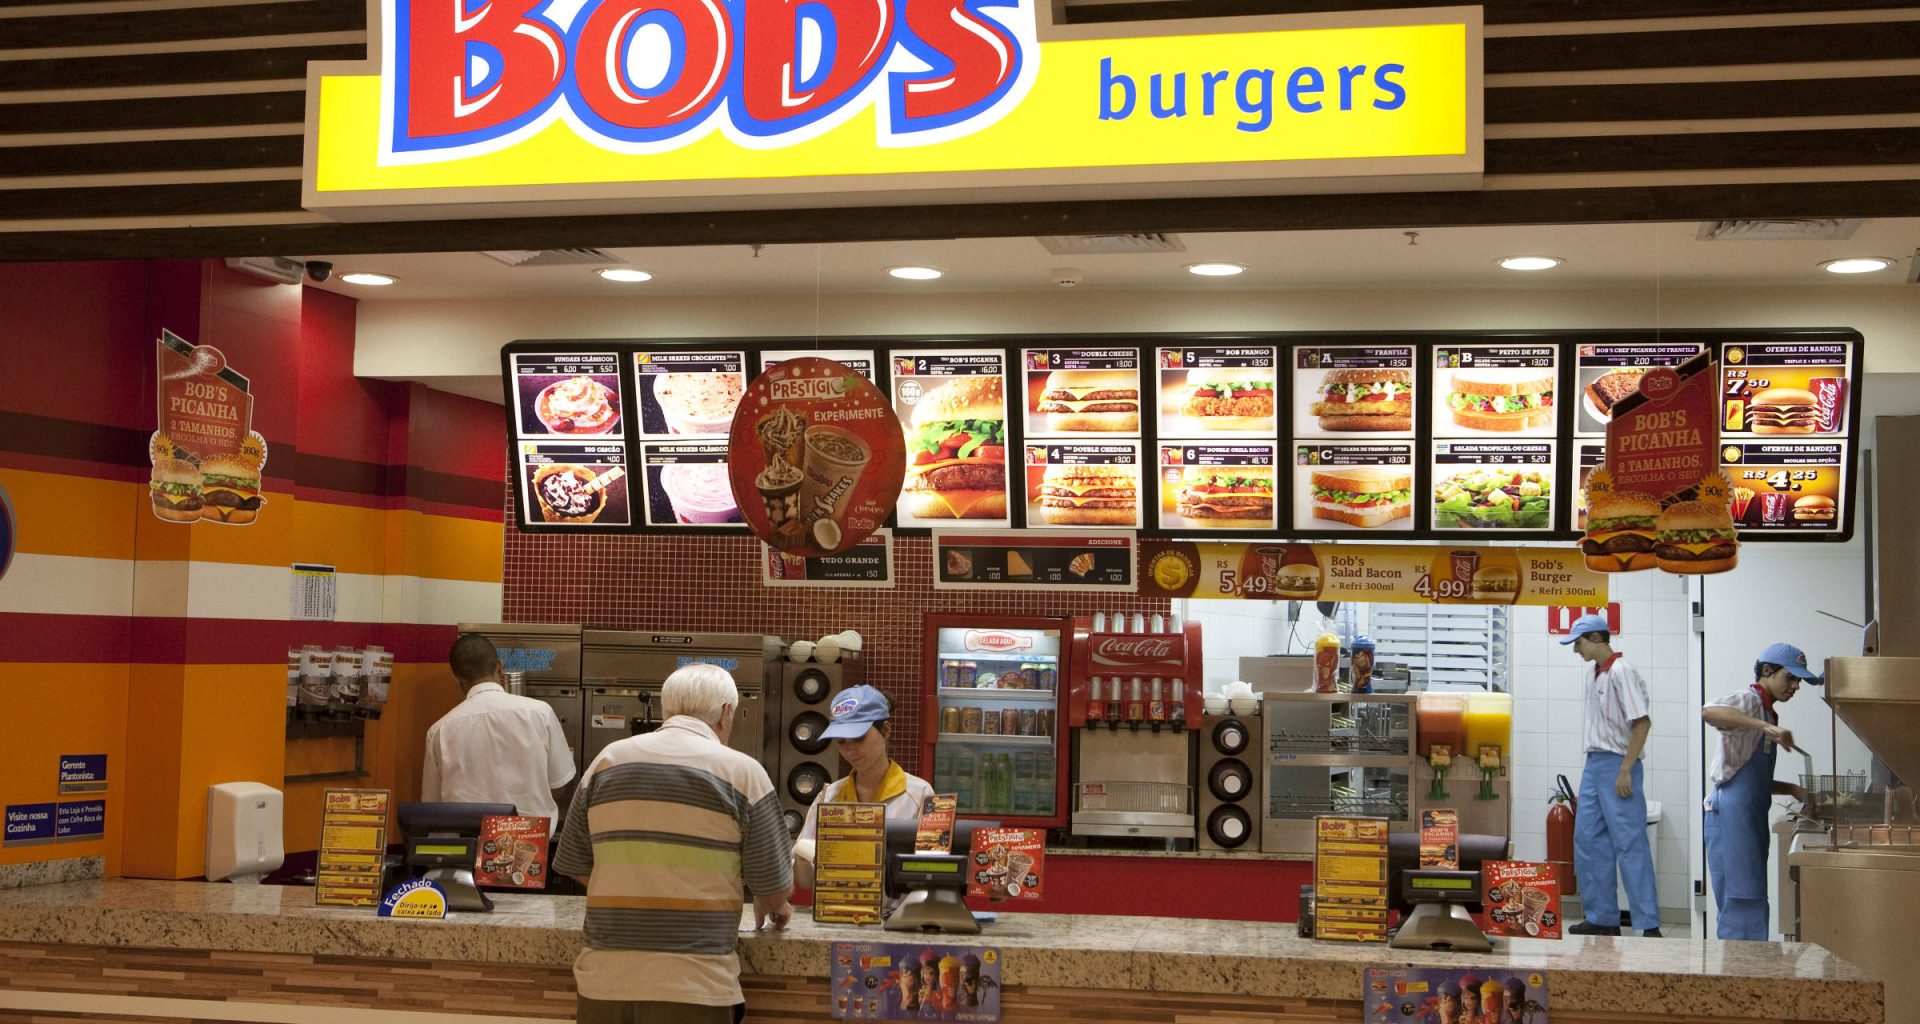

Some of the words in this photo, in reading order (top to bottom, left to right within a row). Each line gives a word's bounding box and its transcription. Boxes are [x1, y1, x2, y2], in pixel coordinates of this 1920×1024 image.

[1098, 57, 1407, 133] burgers
[1052, 353, 1061, 364] 3
[1186, 352, 1195, 362] 5
[1321, 353, 1333, 363] A
[1461, 352, 1472, 363] B
[919, 360, 927, 370] 2
[1727, 370, 1748, 378] R$
[184, 382, 228, 402] BOB'S
[170, 396, 239, 421] PICANHA
[814, 407, 884, 421] EXPERIMENTE
[170, 420, 177, 430] 2
[1635, 409, 1687, 432] BOB'S
[170, 432, 209, 447] ESCOLHA
[210, 437, 217, 446] O
[1619, 428, 1703, 452] PICANHA
[156, 443, 169, 456] 90g
[1051, 448, 1060, 460] 4
[1186, 449, 1196, 460] 6
[1320, 449, 1333, 460] C
[1806, 445, 1837, 453] BANDEJA
[1617, 462, 1626, 473] 2
[1617, 473, 1665, 485] ESCOLHA
[1668, 473, 1676, 481] O
[1743, 471, 1768, 479] R$
[1704, 486, 1723, 497] 90g
[820, 557, 843, 565] TUDO
[845, 557, 880, 565] GRANDE
[1331, 556, 1365, 567] Bob's
[1530, 559, 1564, 570] Bob's
[1331, 567, 1364, 578] Salad
[1366, 568, 1402, 579] Bacon
[1530, 571, 1573, 583] Burger
[1219, 570, 1268, 596] 5,49
[1339, 582, 1363, 590] Refri
[1365, 582, 1395, 591] 300ml
[1414, 574, 1466, 600] 4,99
[1539, 587, 1562, 595] Refri
[1566, 587, 1596, 596] 300ml
[1099, 636, 1171, 658] Coca-Cola
[62, 760, 86, 770] Gerente
[61, 771, 95, 781] Plantonista:
[8, 812, 28, 821] Visite
[29, 811, 48, 820] nossa
[70, 806, 80, 815] Loja
[58, 817, 70, 825] com
[84, 813, 95, 822] Boca
[8, 823, 36, 833] Cozinha
[384, 878, 432, 907] Fechado
[399, 901, 427, 910] Dirija-se
[426, 908, 442, 917] lado
